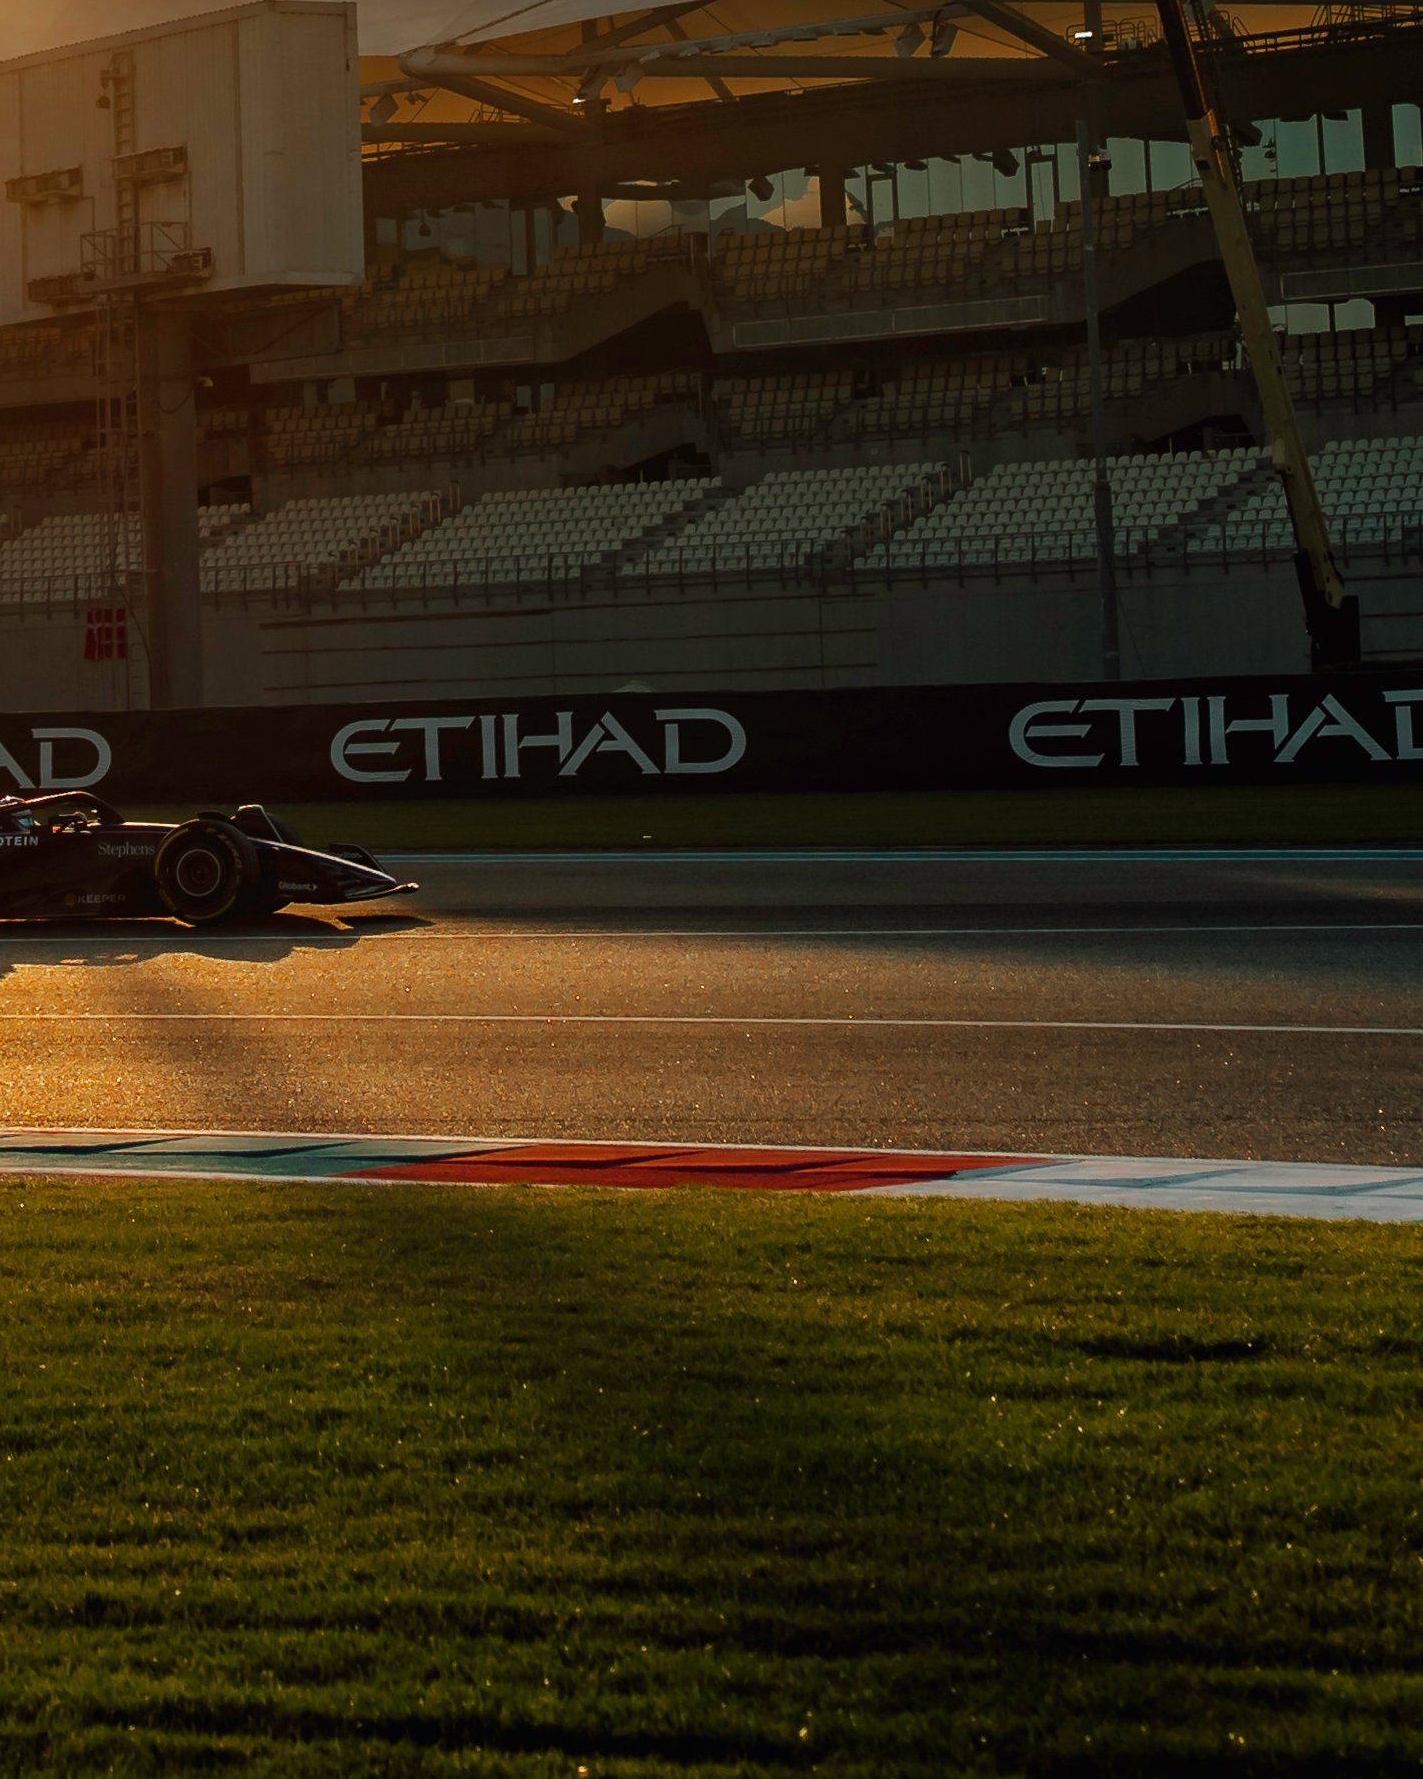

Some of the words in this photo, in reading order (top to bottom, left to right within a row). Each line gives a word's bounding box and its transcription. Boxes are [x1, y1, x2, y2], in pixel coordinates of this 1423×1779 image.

[330, 707, 747, 782] ETIHAD
[97, 840, 157, 858] Stephens
[77, 893, 127, 904] KEEPER
